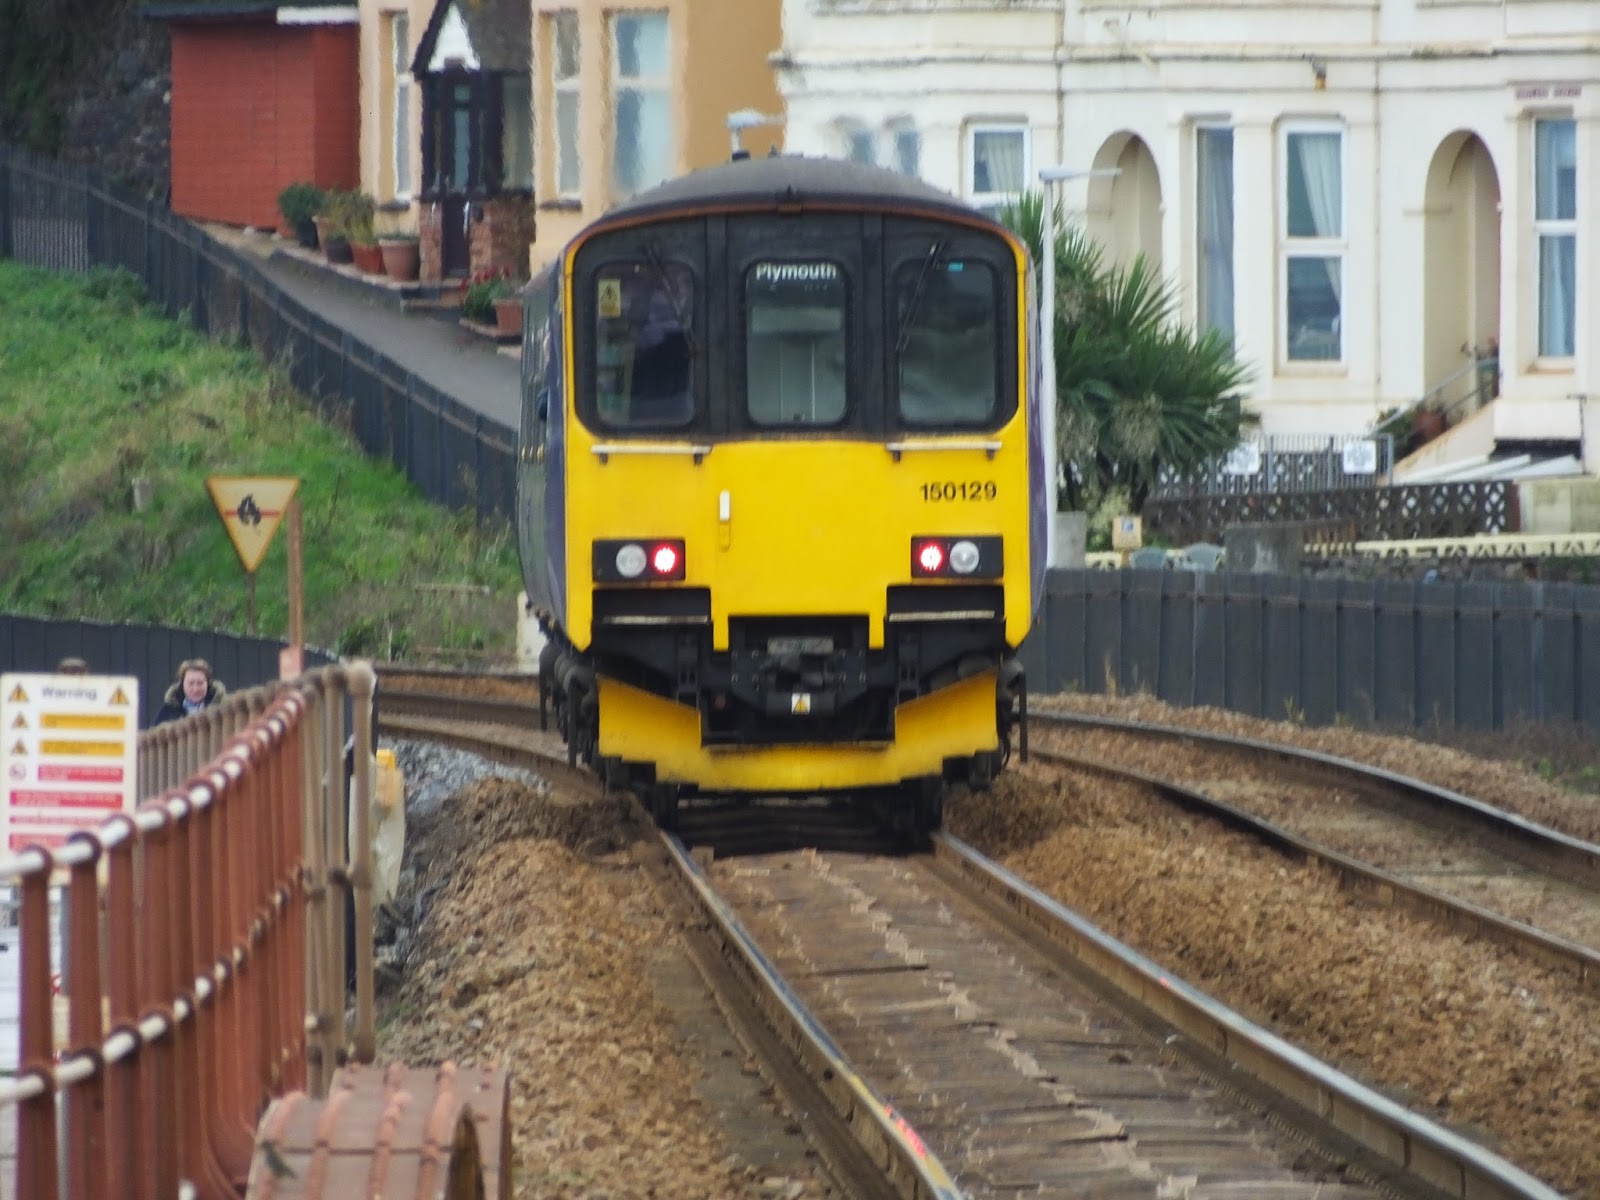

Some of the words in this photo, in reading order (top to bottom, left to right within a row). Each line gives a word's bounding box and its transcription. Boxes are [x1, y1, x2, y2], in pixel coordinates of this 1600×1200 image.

[756, 262, 837, 283] Plymouth
[920, 480, 997, 502] 150129
[42, 686, 97, 700] Warning
